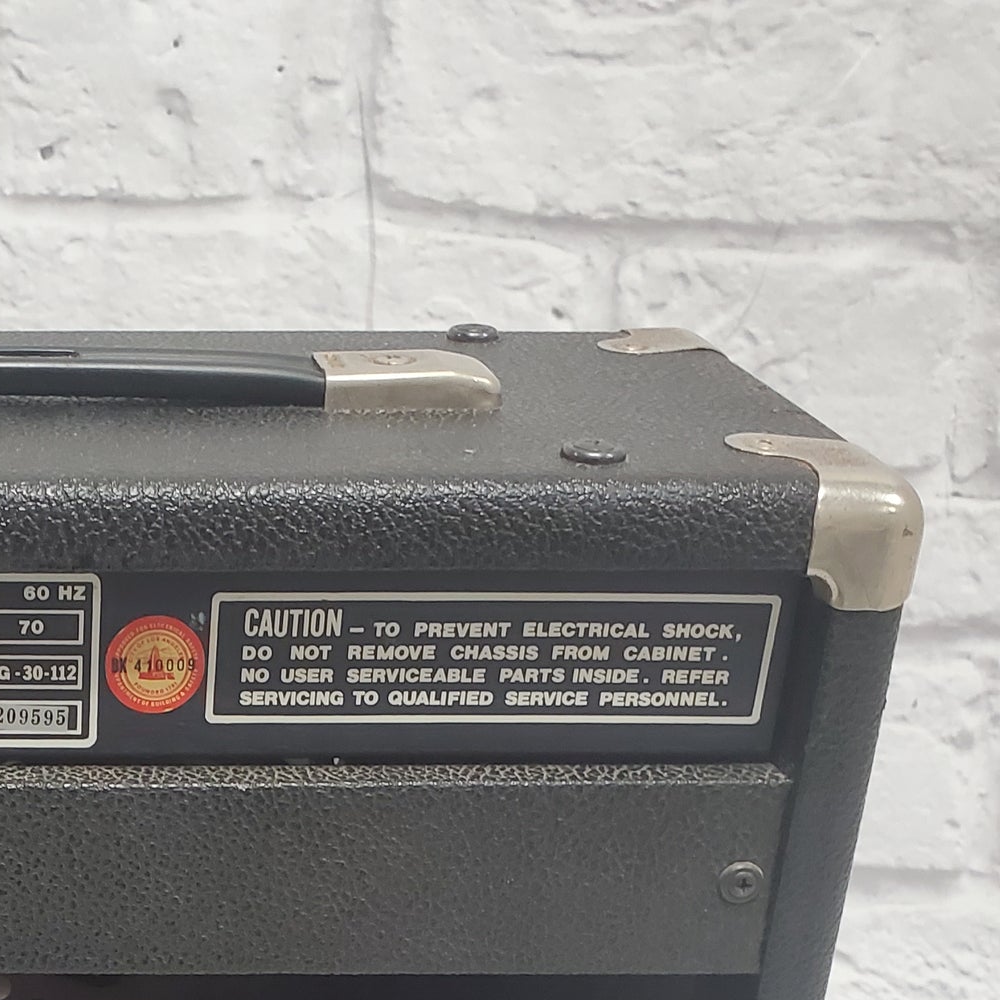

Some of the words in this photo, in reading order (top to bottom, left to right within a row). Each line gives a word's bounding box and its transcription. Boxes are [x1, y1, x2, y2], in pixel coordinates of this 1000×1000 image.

[22, 585, 51, 601] 60
[57, 586, 87, 601] HZ
[19, 620, 45, 636] 70
[243, 607, 343, 638] CAUTION
[373, 621, 400, 638] TO
[414, 621, 511, 638] PREVENT
[522, 621, 650, 640] ELECTRICAL
[662, 622, 742, 642] SHOCK,
[241, 645, 272, 661] DO
[289, 645, 332, 661] NOT
[347, 645, 436, 661] REMOVE
[450, 645, 539, 662] CHASSIS
[551, 645, 610, 662] FROM
[240, 668, 270, 684] NO
[280, 668, 333, 684] USER
[346, 668, 487, 684] SERVICEABLE
[499, 668, 566, 685] PARTS
[661, 669, 730, 686] REFER
[239, 691, 344, 708] SERVICING
[352, 691, 380, 707] TO
[387, 691, 494, 708] QUALIFIED
[504, 691, 589, 708] SERVICE
[599, 691, 728, 708] PERSONNEL.
